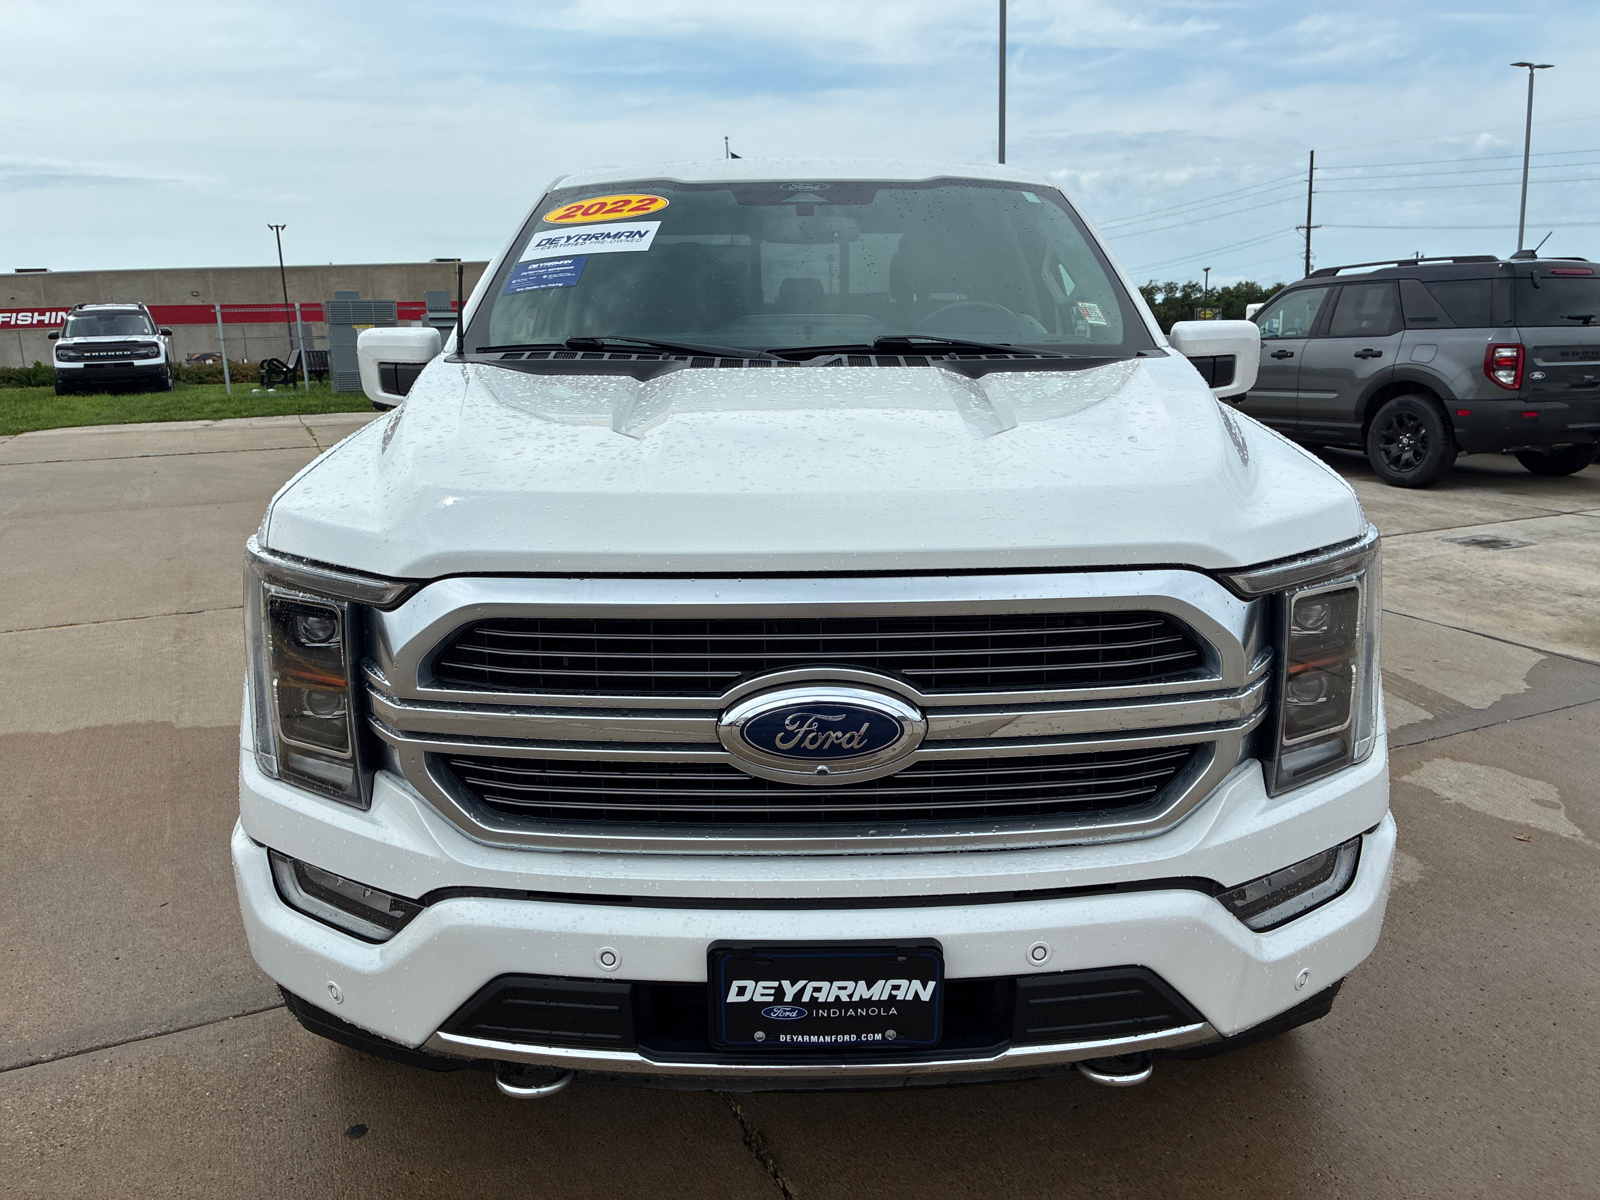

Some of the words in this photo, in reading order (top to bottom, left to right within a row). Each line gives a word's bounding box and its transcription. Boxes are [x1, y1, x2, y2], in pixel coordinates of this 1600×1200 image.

[554, 197, 659, 221] 2022
[534, 230, 651, 248] DEYARMAN
[541, 241, 587, 251] CERTIFIED
[774, 712, 870, 750] Ford
[726, 979, 937, 1003] DEYARMAN
[770, 1006, 798, 1018] Ford
[813, 1007, 898, 1018] INDIANOLA
[779, 1033, 882, 1043] DEYARMANFORD.COM
